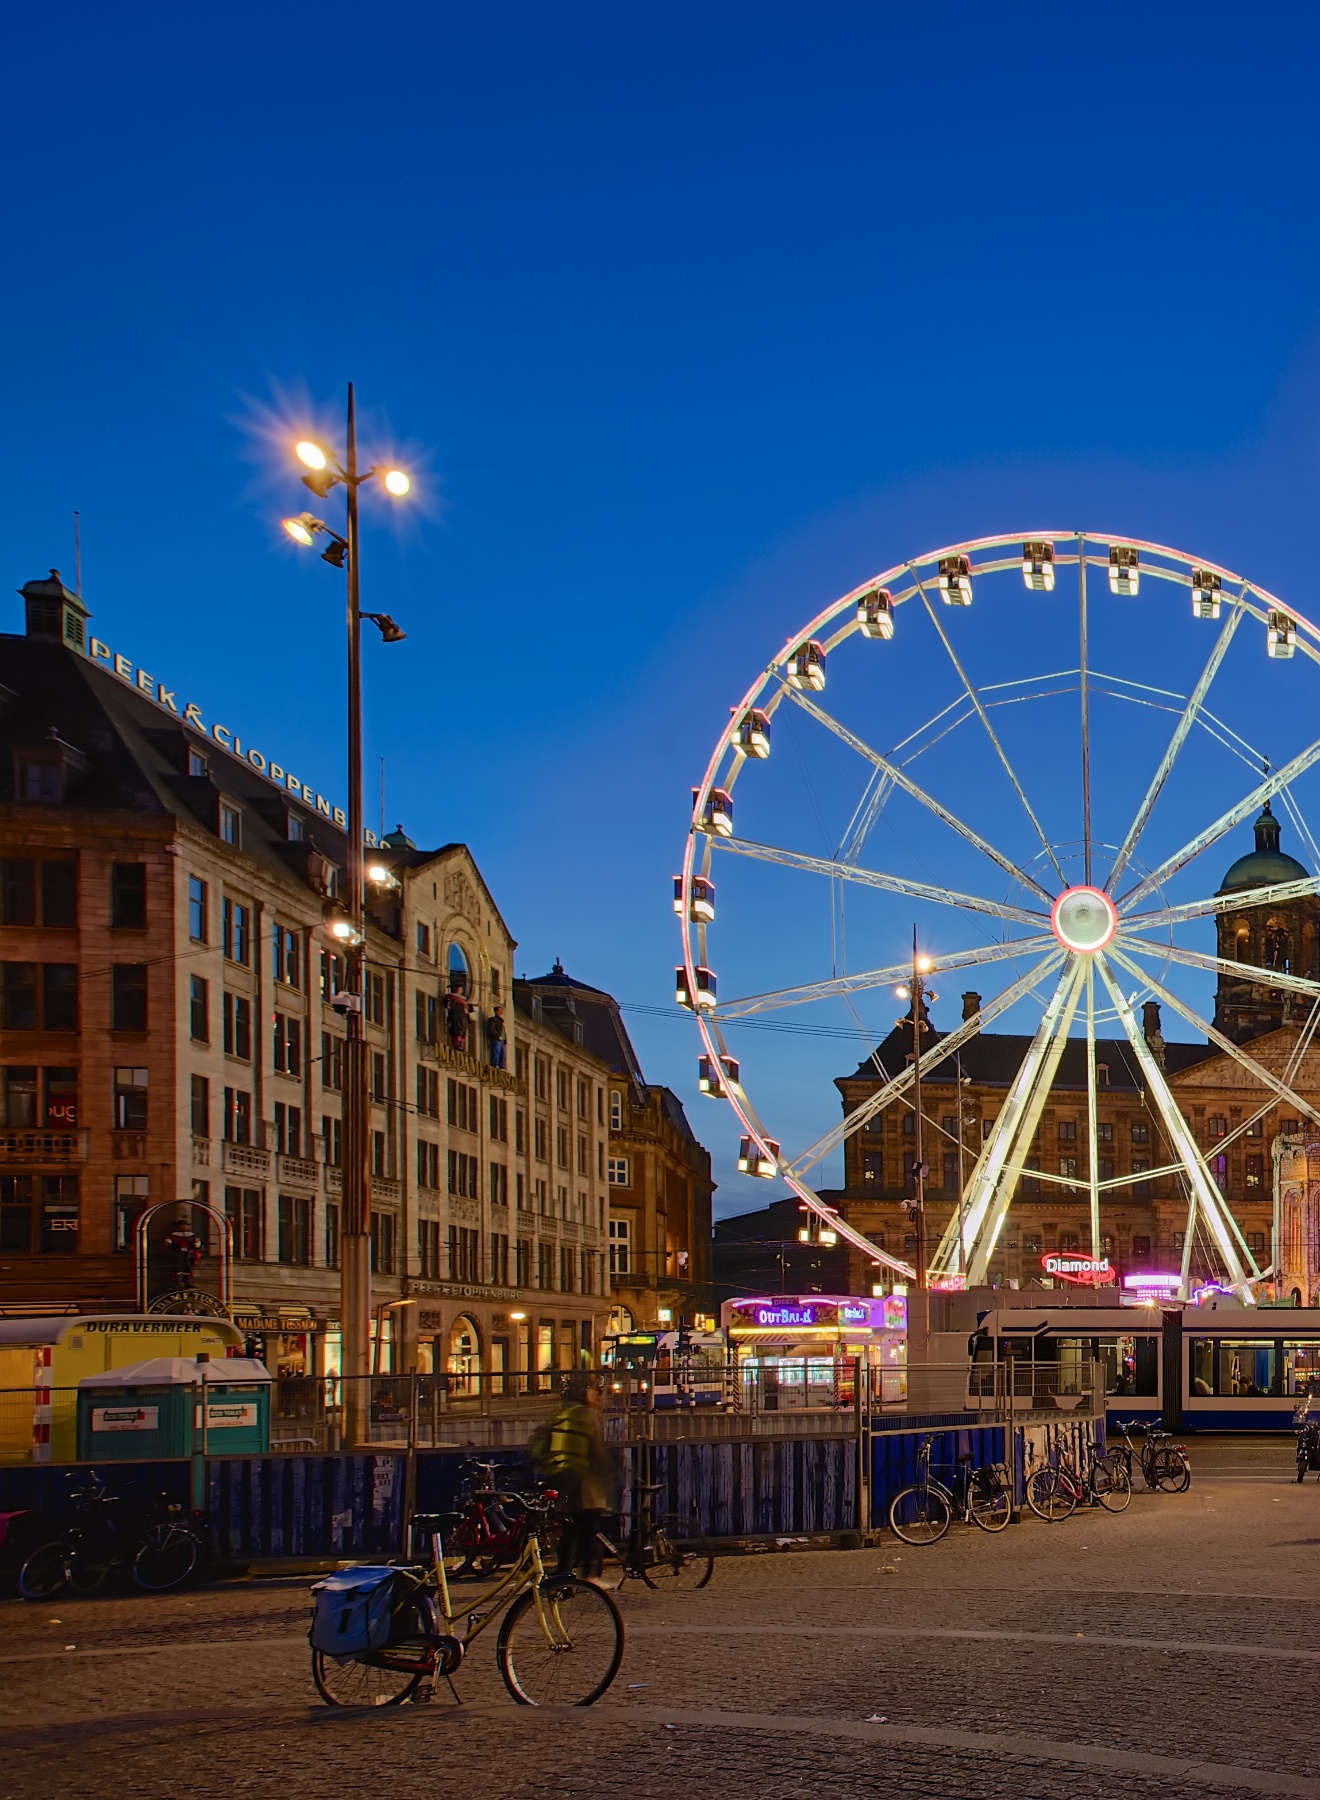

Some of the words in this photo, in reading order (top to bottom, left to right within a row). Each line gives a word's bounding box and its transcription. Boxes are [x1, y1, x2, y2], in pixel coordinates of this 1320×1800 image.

[1046, 1258, 1109, 1272] Diamond
[86, 1321, 131, 1333] DURA
[132, 1321, 201, 1333] VERMEER
[238, 1317, 279, 1331] MADAME
